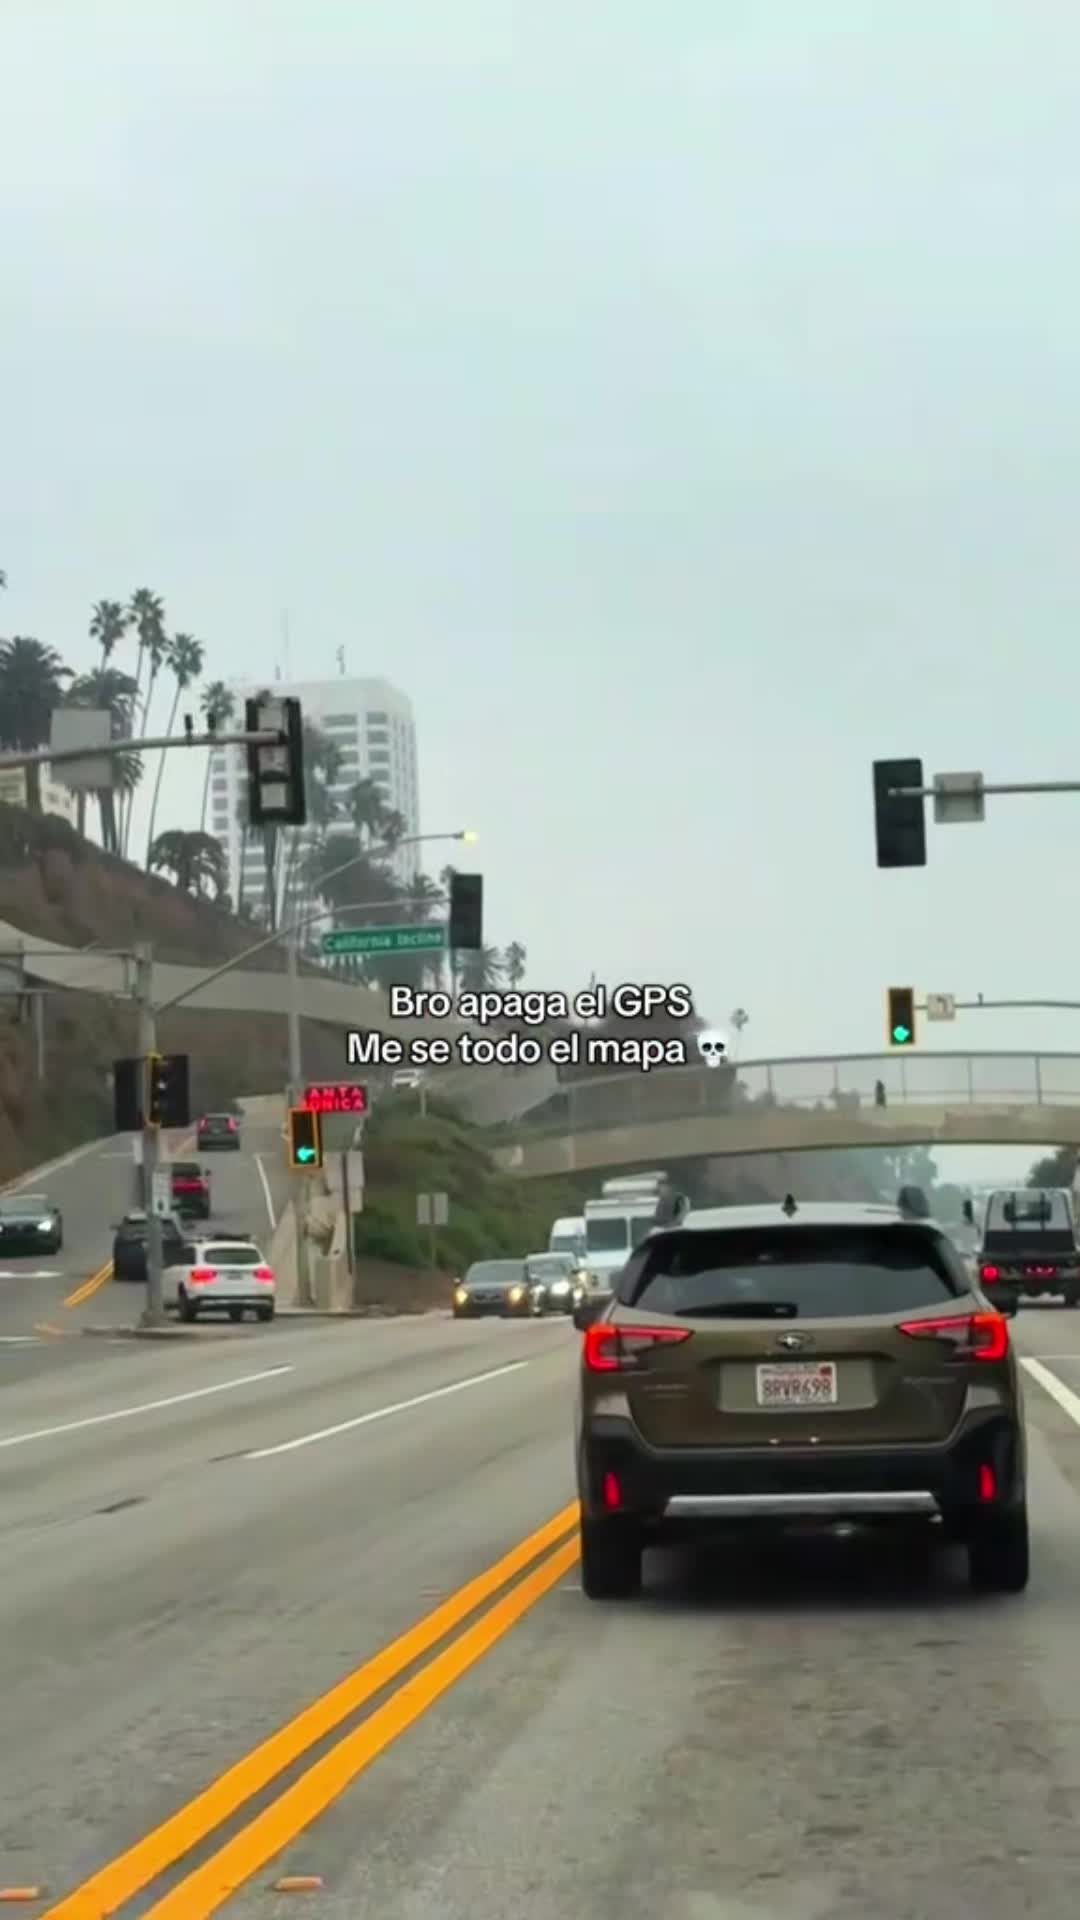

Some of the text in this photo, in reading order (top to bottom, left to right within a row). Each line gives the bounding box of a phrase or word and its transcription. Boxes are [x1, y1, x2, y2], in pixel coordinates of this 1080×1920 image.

[325, 932, 442, 950] California Incline
[309, 1087, 362, 1098] ANTA
